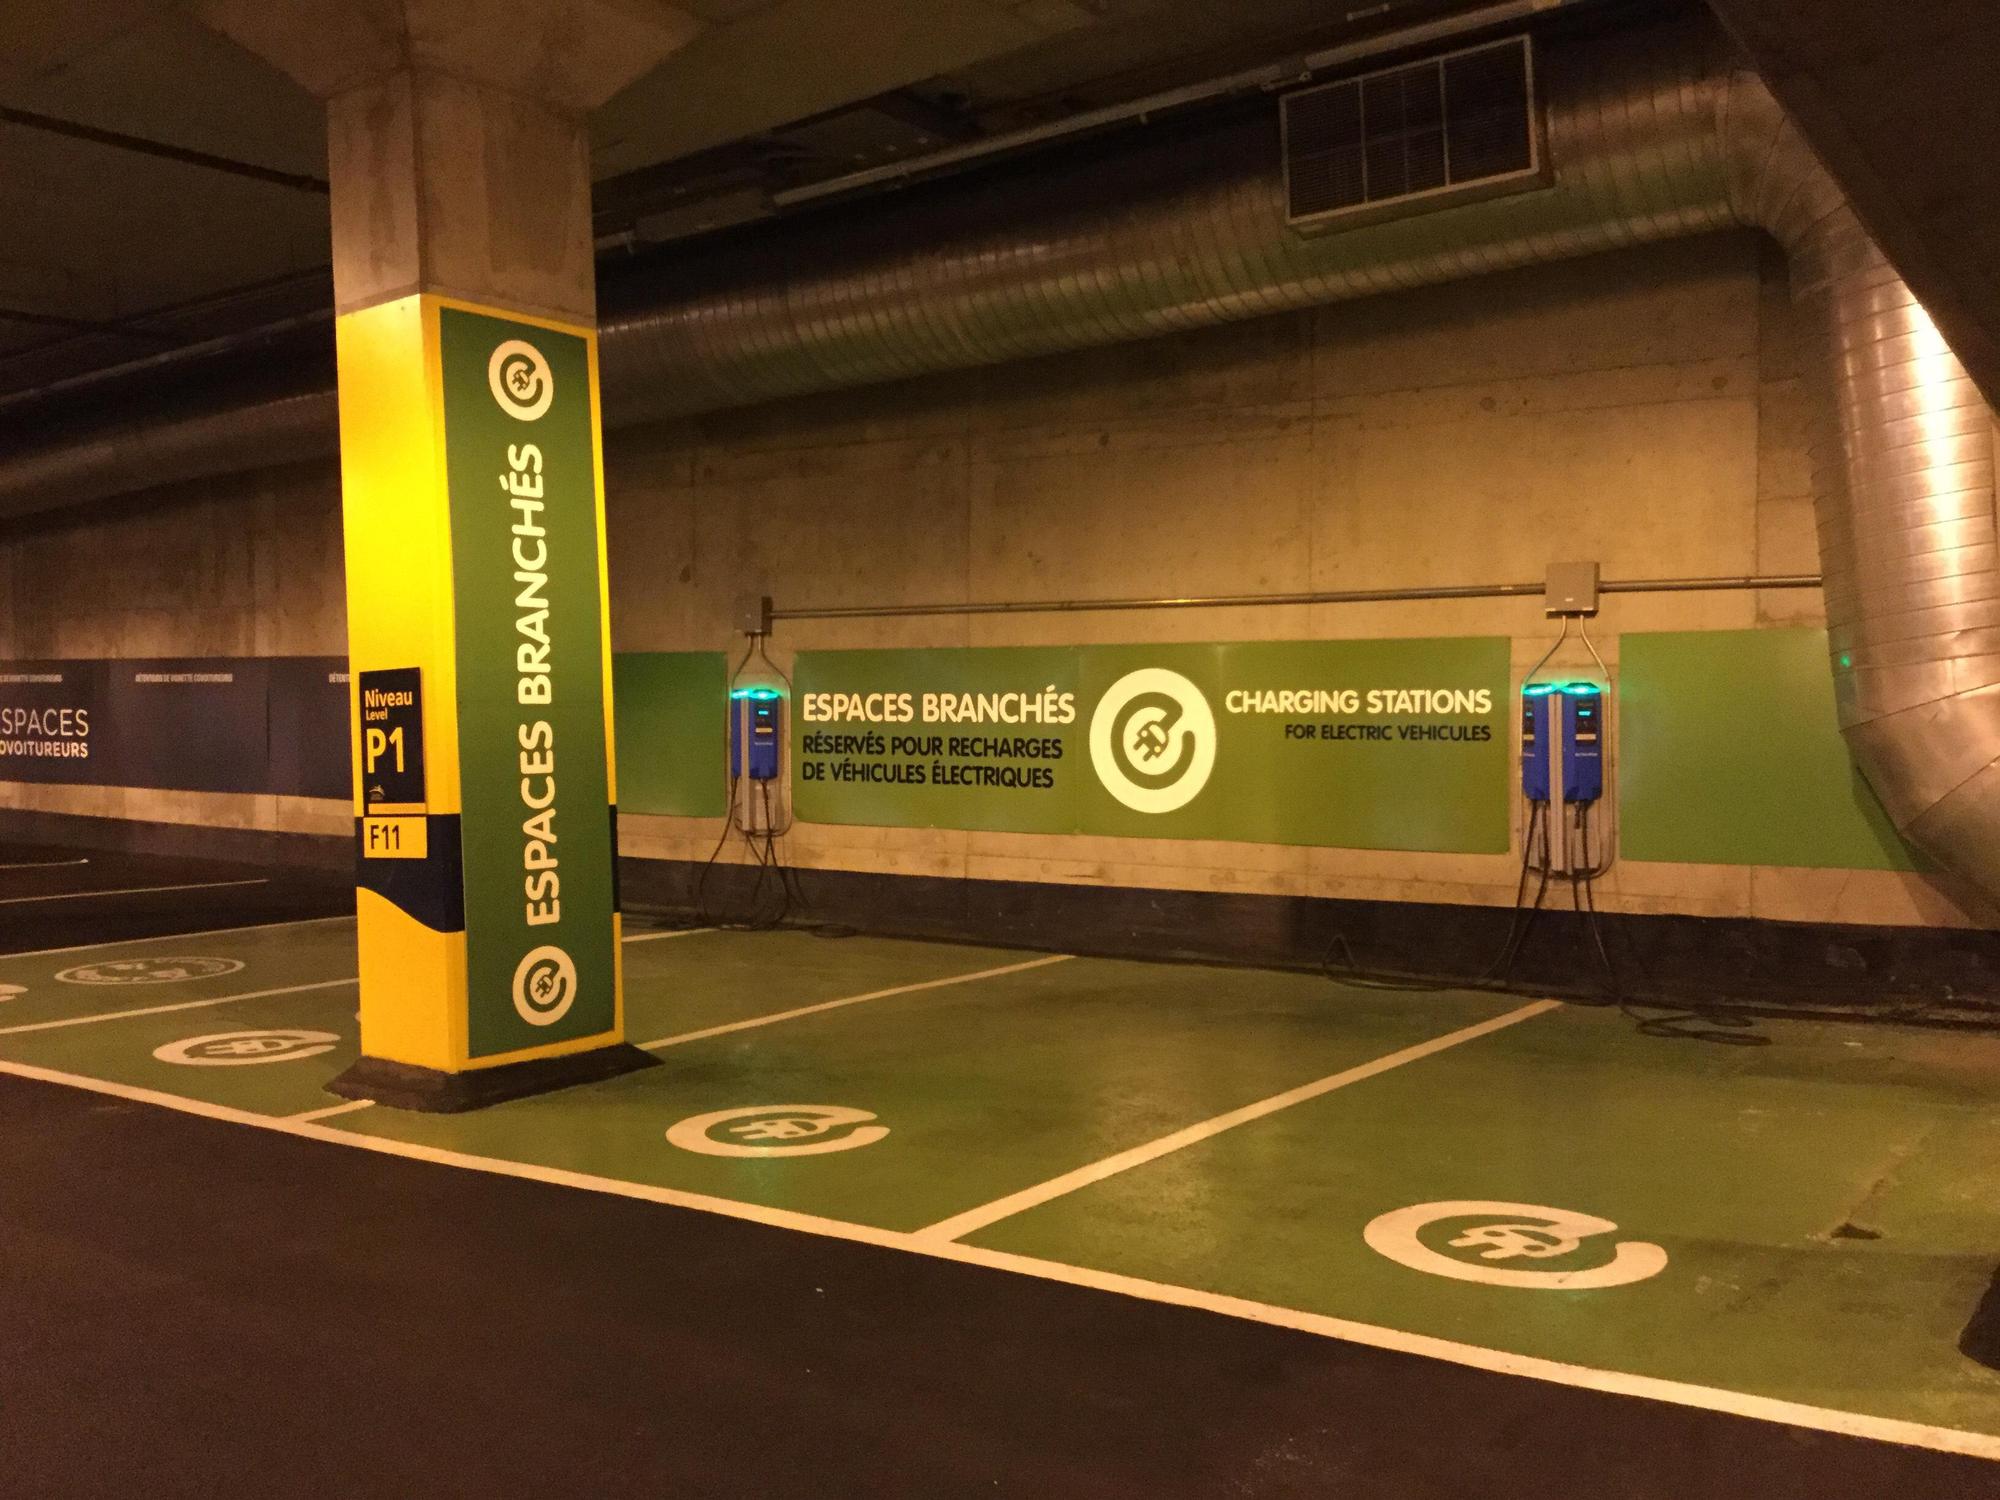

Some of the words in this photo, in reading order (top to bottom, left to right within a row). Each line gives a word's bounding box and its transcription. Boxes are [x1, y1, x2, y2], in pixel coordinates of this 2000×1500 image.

[499, 443, 552, 705] BRANCHÉS
[364, 690, 413, 708] Niveau
[803, 692, 914, 722] ESPACES
[922, 684, 1076, 724] BRANCHÉS
[1225, 690, 1360, 714] CHARGING
[1366, 689, 1493, 714] STATIONS
[0, 708, 89, 737] SPACES
[365, 708, 388, 721] Level
[802, 730, 885, 755] RÉSERVÉS
[891, 736, 944, 757] POUR
[949, 737, 1063, 759] RECHARGES
[1285, 724, 1316, 740] FOR
[1321, 724, 1393, 741] ELECTRIC
[1398, 725, 1492, 742] VEHICULES
[0, 740, 88, 758] OVOITUREURS
[366, 727, 405, 773] P1
[802, 761, 825, 781] DE
[831, 758, 926, 784] VÉHICULES
[932, 760, 1055, 789] ÉLECTRIQUES
[370, 825, 400, 850] F11
[518, 720, 561, 926] ESPACES
